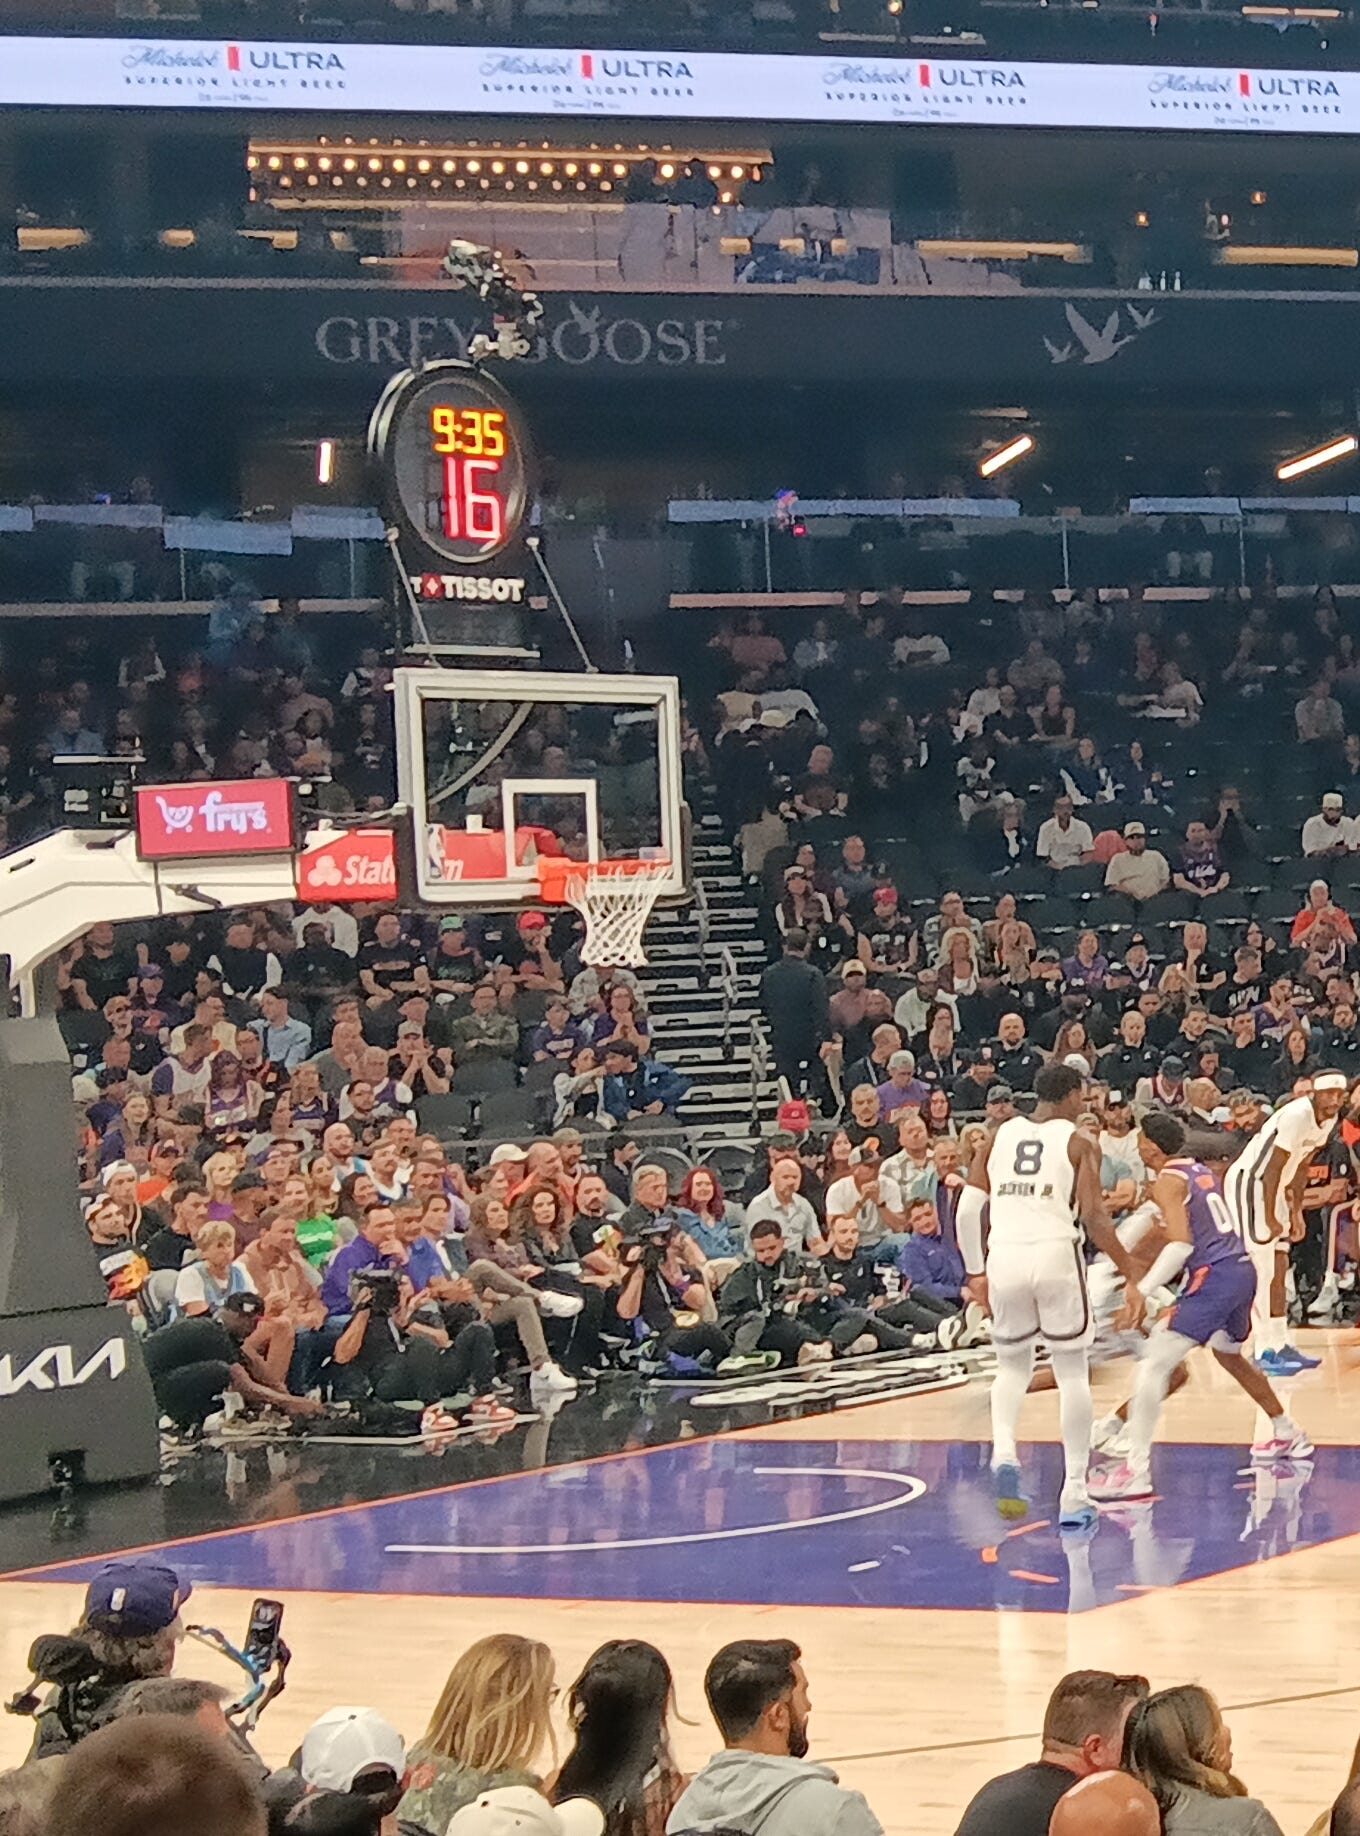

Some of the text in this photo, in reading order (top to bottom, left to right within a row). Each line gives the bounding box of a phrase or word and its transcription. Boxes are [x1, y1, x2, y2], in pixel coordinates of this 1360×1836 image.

[249, 50, 346, 71] ULTRA
[601, 58, 694, 79] ULTRA
[938, 68, 1026, 88] ULTRA
[1257, 76, 1340, 97] ULTRA
[314, 316, 478, 364] GREY
[432, 407, 505, 457] 9:35
[446, 456, 502, 539] 16
[440, 576, 525, 602] TISSOT
[199, 790, 268, 834] fry's
[343, 854, 396, 886] Stat
[1013, 1139, 1045, 1176] 8
[1206, 1191, 1234, 1234] 0
